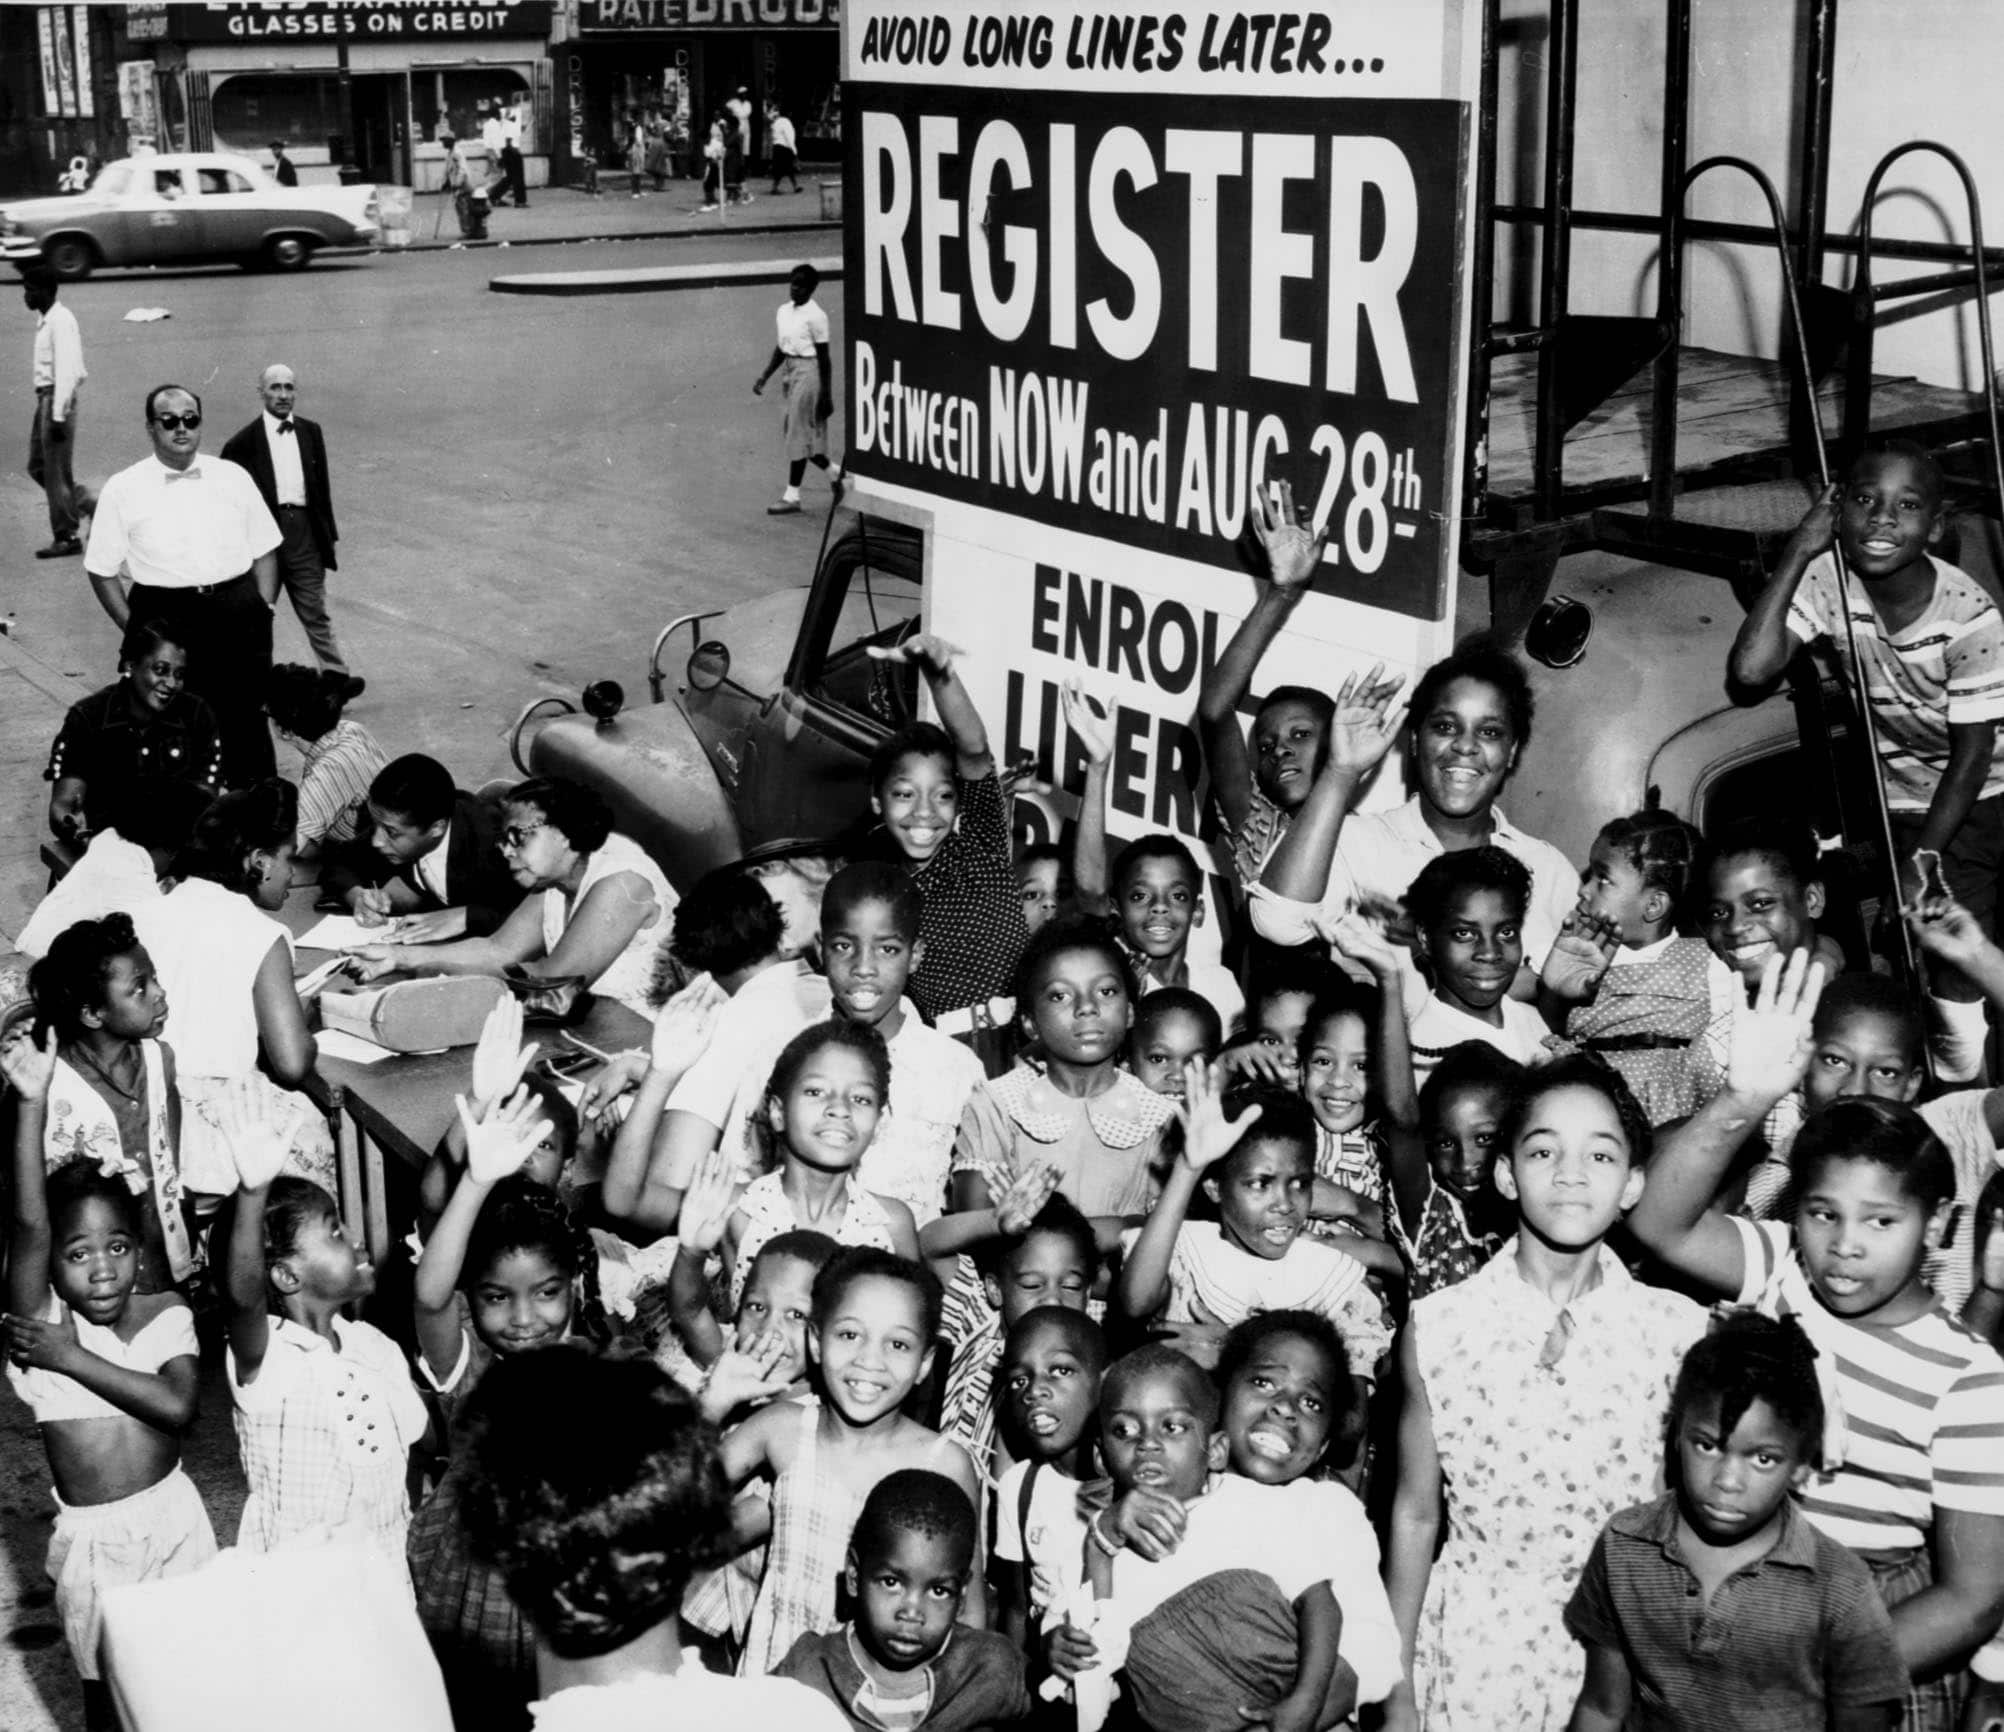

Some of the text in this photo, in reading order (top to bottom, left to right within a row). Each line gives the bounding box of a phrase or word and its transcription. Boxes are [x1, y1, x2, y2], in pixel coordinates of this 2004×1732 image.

[228, 10, 508, 35] GLASSES ON CREDIT
[861, 12, 1384, 74] AVOID LONG LINES LATER...
[862, 111, 1420, 404] REGISTER
[855, 340, 1421, 574] Between NOW and AUG 28th
